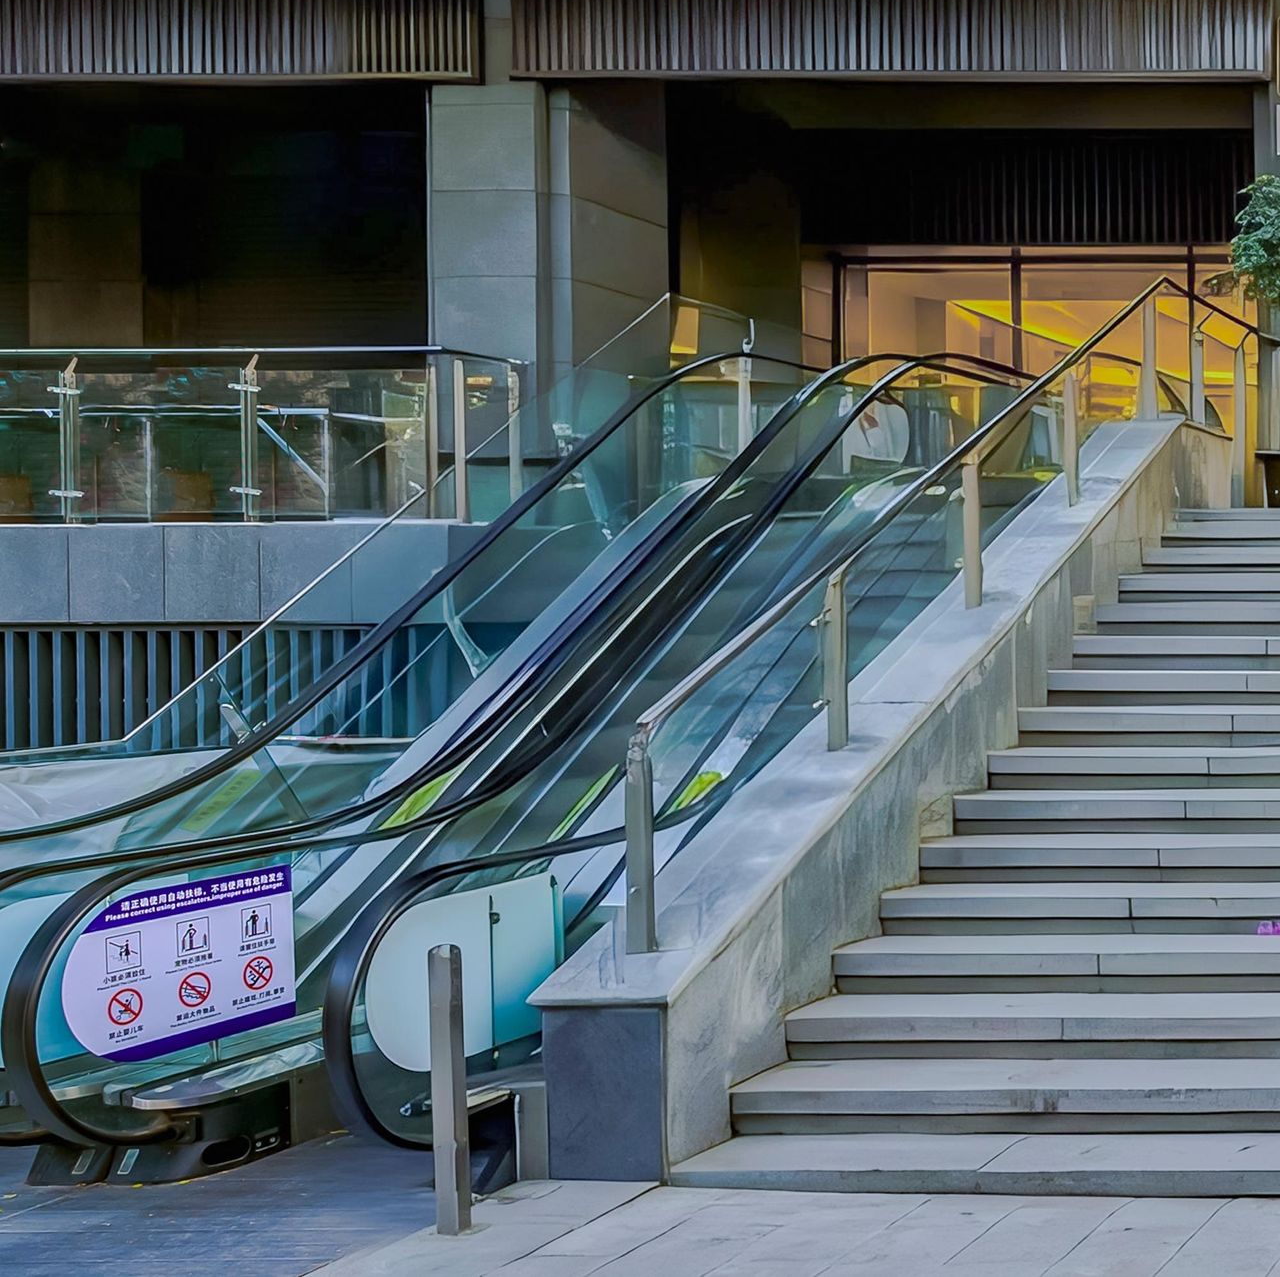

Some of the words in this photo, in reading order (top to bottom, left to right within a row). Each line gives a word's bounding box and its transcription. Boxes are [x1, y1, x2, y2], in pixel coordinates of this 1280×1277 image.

[105, 912, 129, 922] Please
[130, 906, 155, 917] correct
[156, 902, 175, 912] using
